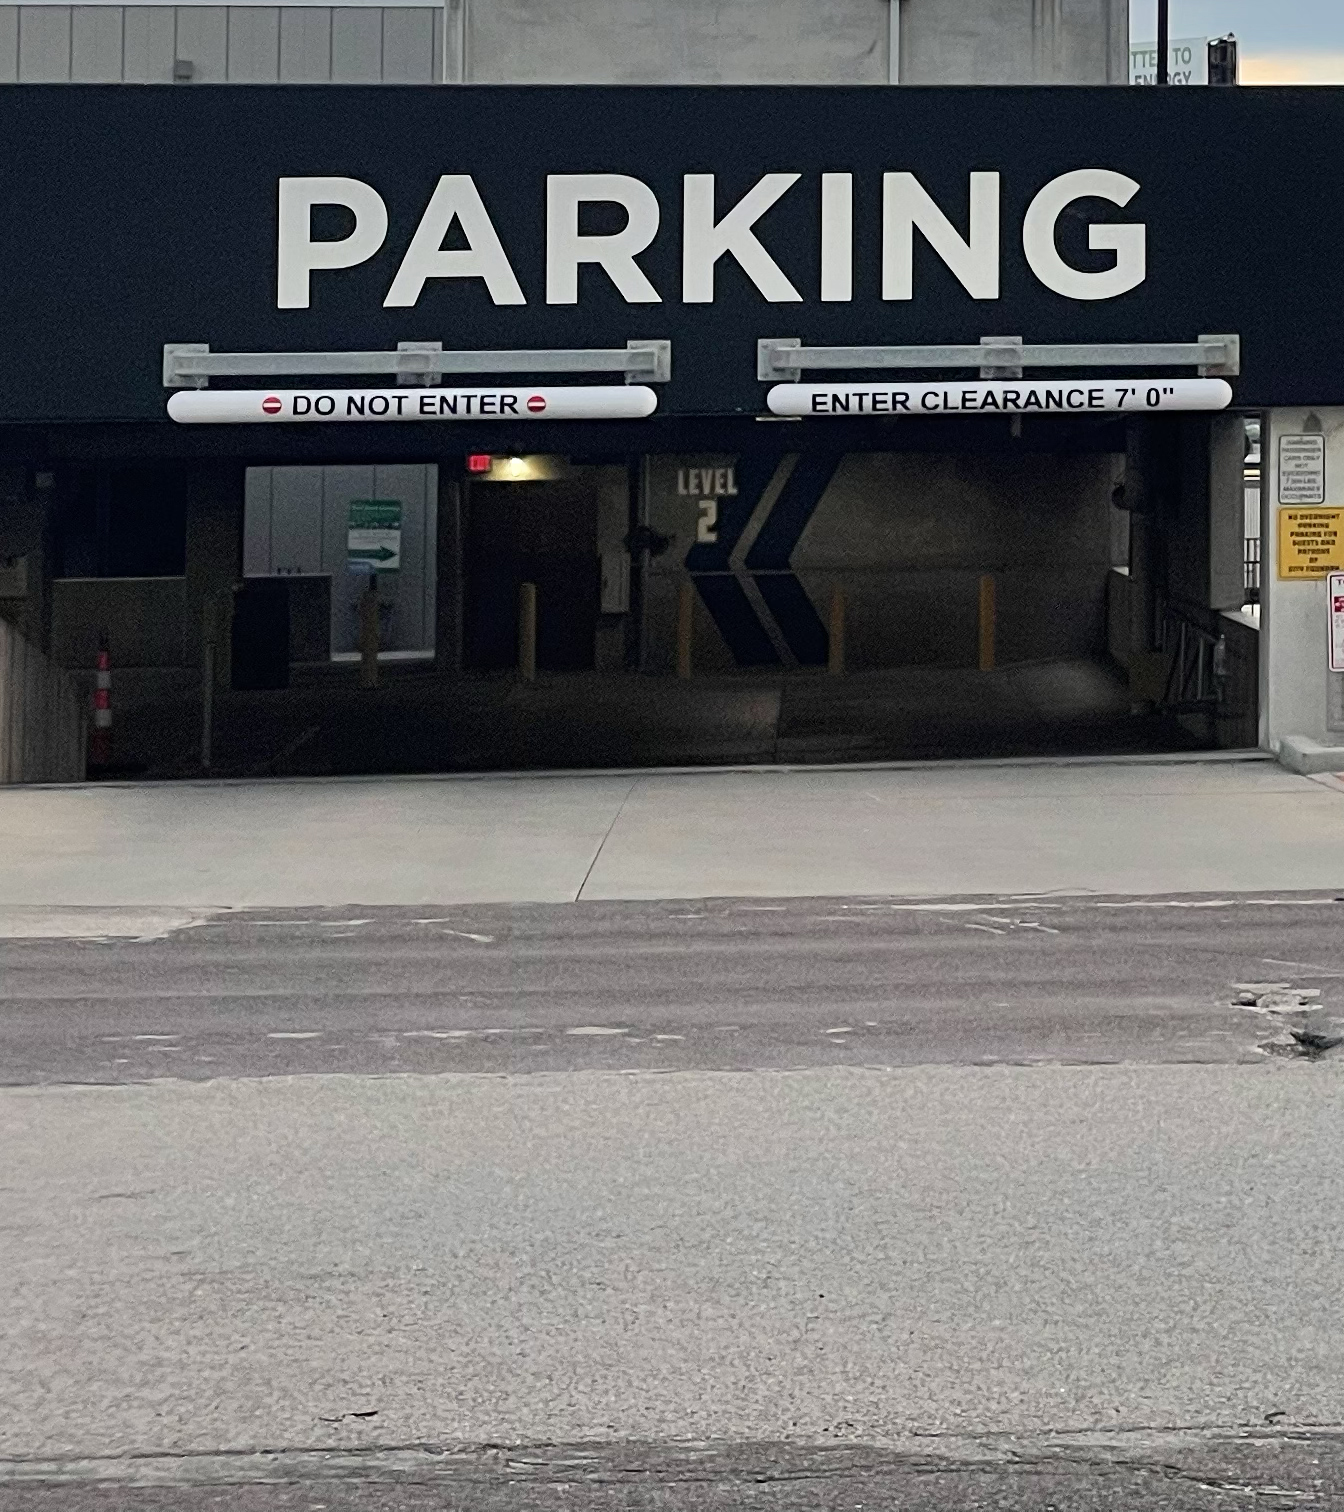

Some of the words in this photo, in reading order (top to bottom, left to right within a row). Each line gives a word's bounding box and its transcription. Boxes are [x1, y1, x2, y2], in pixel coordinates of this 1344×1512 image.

[1172, 46, 1192, 65] TO
[276, 168, 1147, 312] PARKING
[292, 395, 336, 416] DO
[346, 394, 410, 416] NOT
[419, 394, 520, 415] ENTER
[811, 391, 911, 413] ENTER
[919, 389, 1106, 411] CLEARANCE
[1114, 388, 1137, 408] 7'
[677, 467, 738, 496] LEVEL
[697, 500, 717, 542] 2
